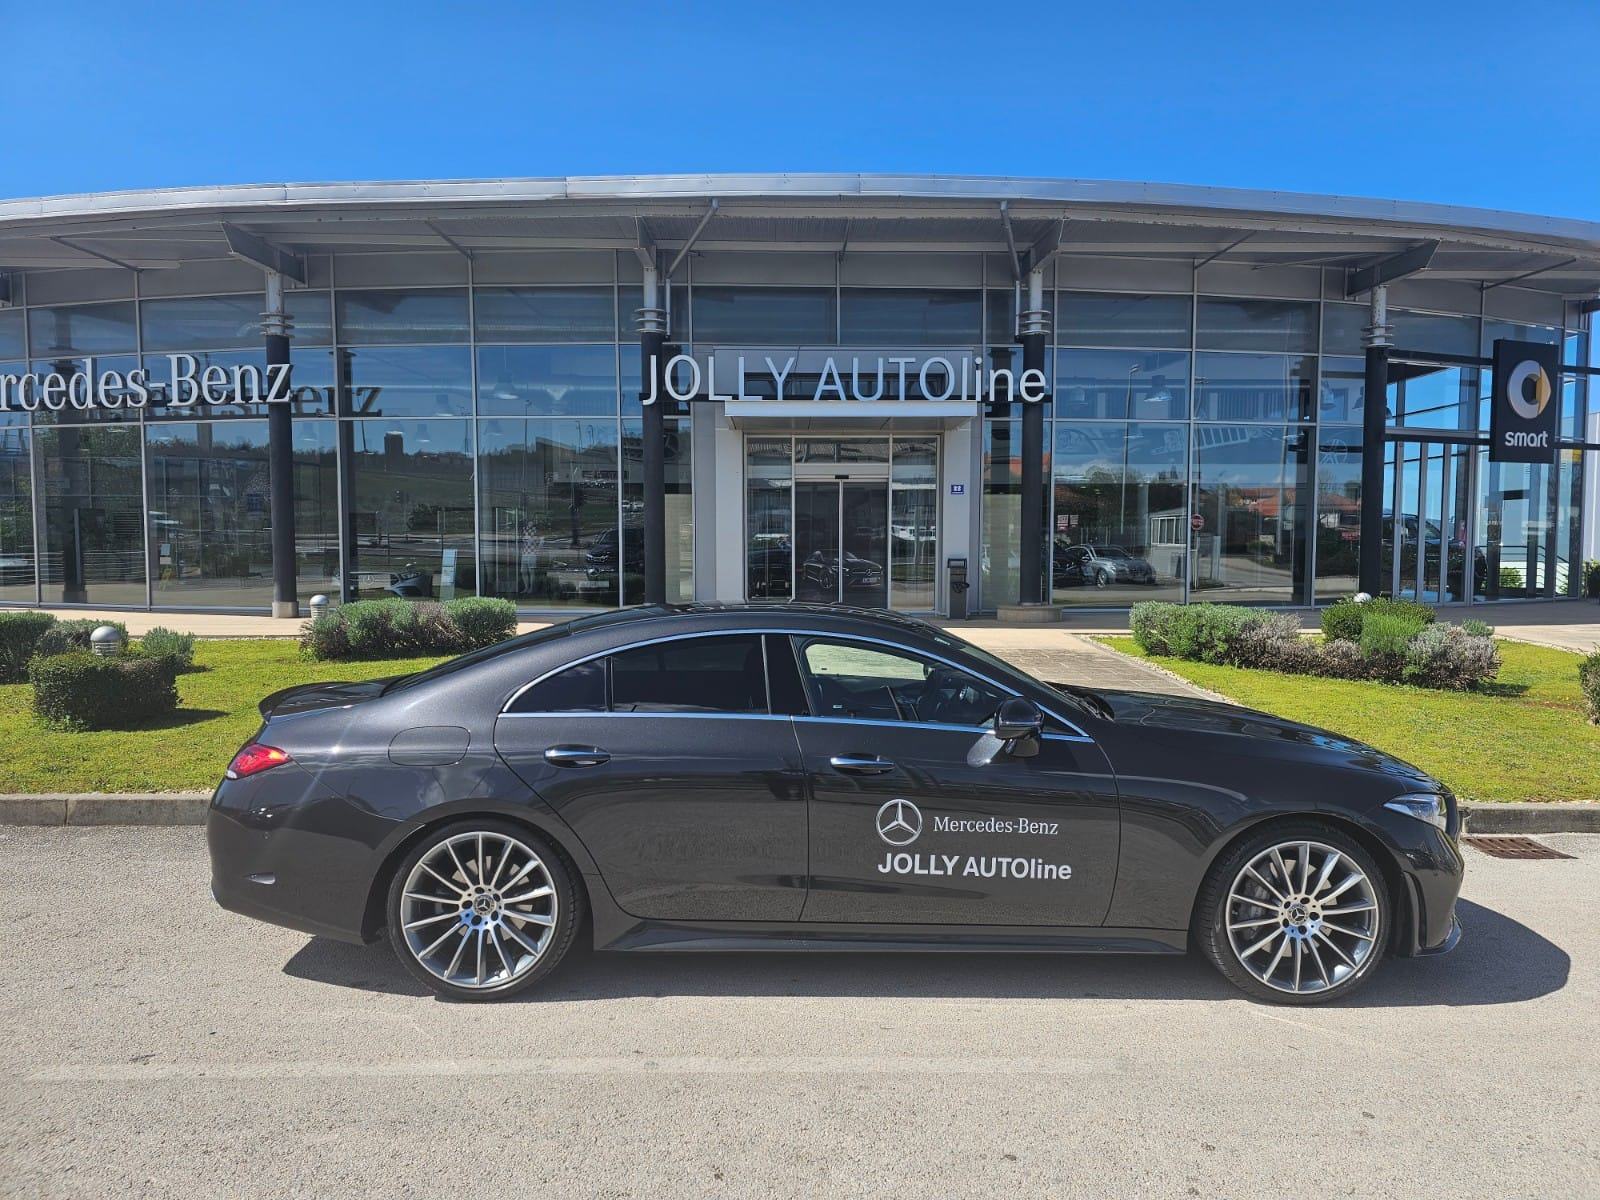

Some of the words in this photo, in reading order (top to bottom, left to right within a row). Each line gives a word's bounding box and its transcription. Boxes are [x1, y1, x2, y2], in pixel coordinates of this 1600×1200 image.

[642, 354, 795, 406] JOLLY
[813, 357, 1047, 402] AUTOline
[1504, 430, 1549, 448] smart
[933, 816, 1059, 836] Mercedes-Benz
[877, 853, 960, 876] JOLLY
[962, 856, 1072, 880] AUTOline
